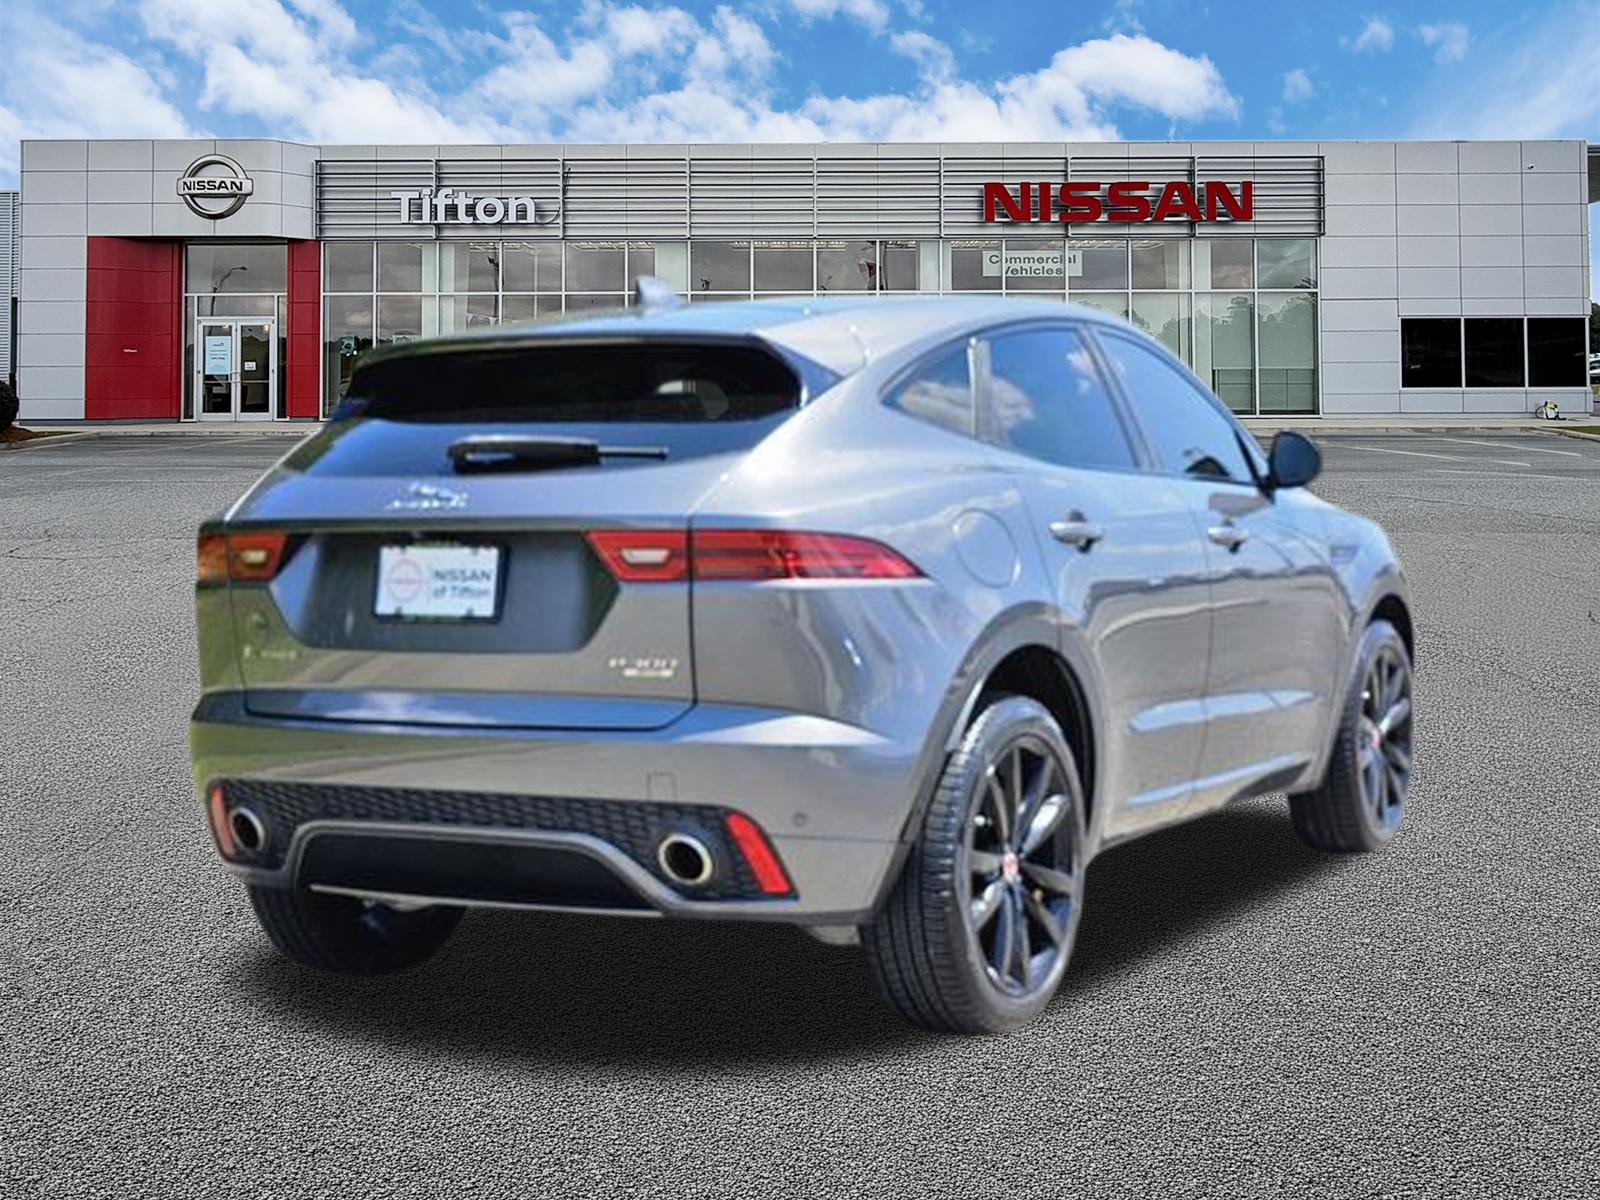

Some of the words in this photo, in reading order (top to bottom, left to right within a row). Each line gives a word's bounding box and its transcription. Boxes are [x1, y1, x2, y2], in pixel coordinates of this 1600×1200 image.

[183, 181, 243, 191] NISSAN
[391, 188, 536, 224] Tifton
[984, 181, 1253, 222] NISSAN
[433, 569, 491, 582] NISSAN
